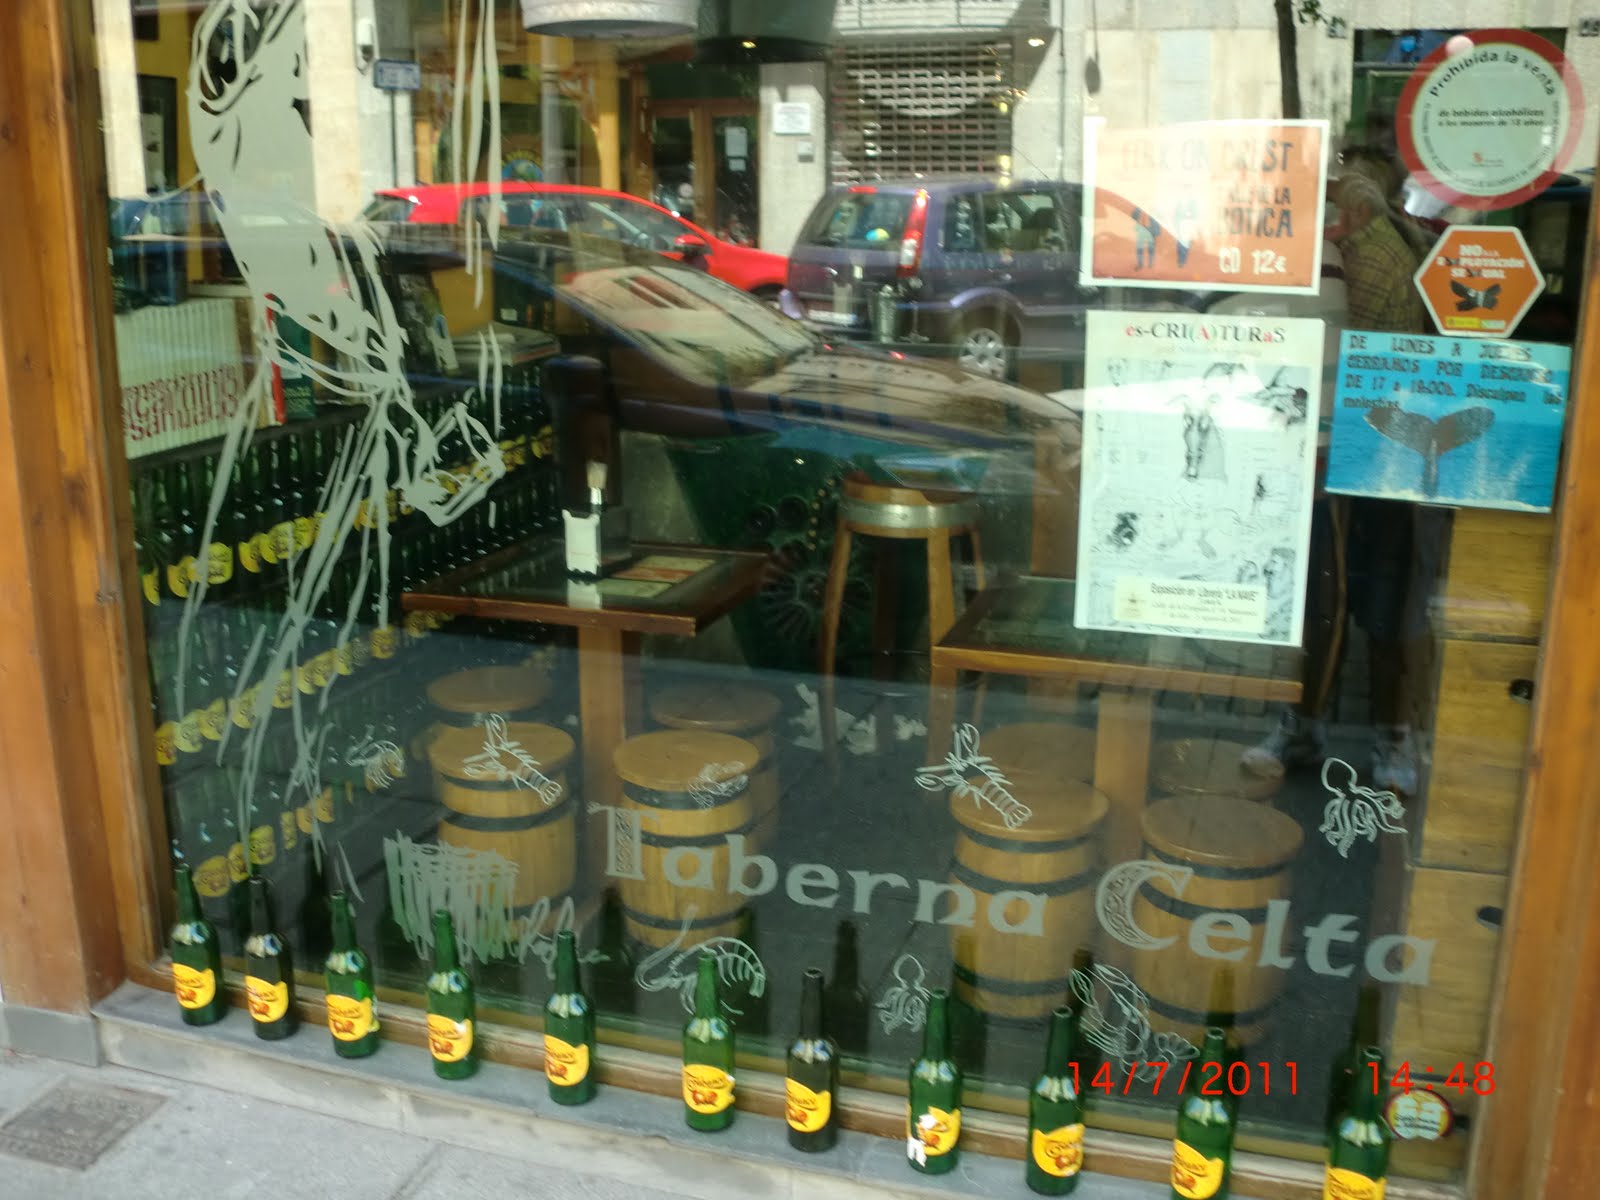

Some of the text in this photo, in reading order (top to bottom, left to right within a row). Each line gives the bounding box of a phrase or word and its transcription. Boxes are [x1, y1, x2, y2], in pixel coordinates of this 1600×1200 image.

[1430, 51, 1555, 97] Prohibida la venta
[1274, 186, 1291, 205] LA
[1219, 247, 1242, 274] CD
[1350, 334, 1368, 350] DE
[1391, 336, 1435, 354] LUNES
[1451, 342, 1462, 356] A
[1347, 355, 1420, 374] CERRAMOS
[1436, 361, 1463, 377] POR
[1345, 373, 1363, 389] DE
[1372, 376, 1386, 391] 17
[586, 801, 1437, 986] Taberna Celta
